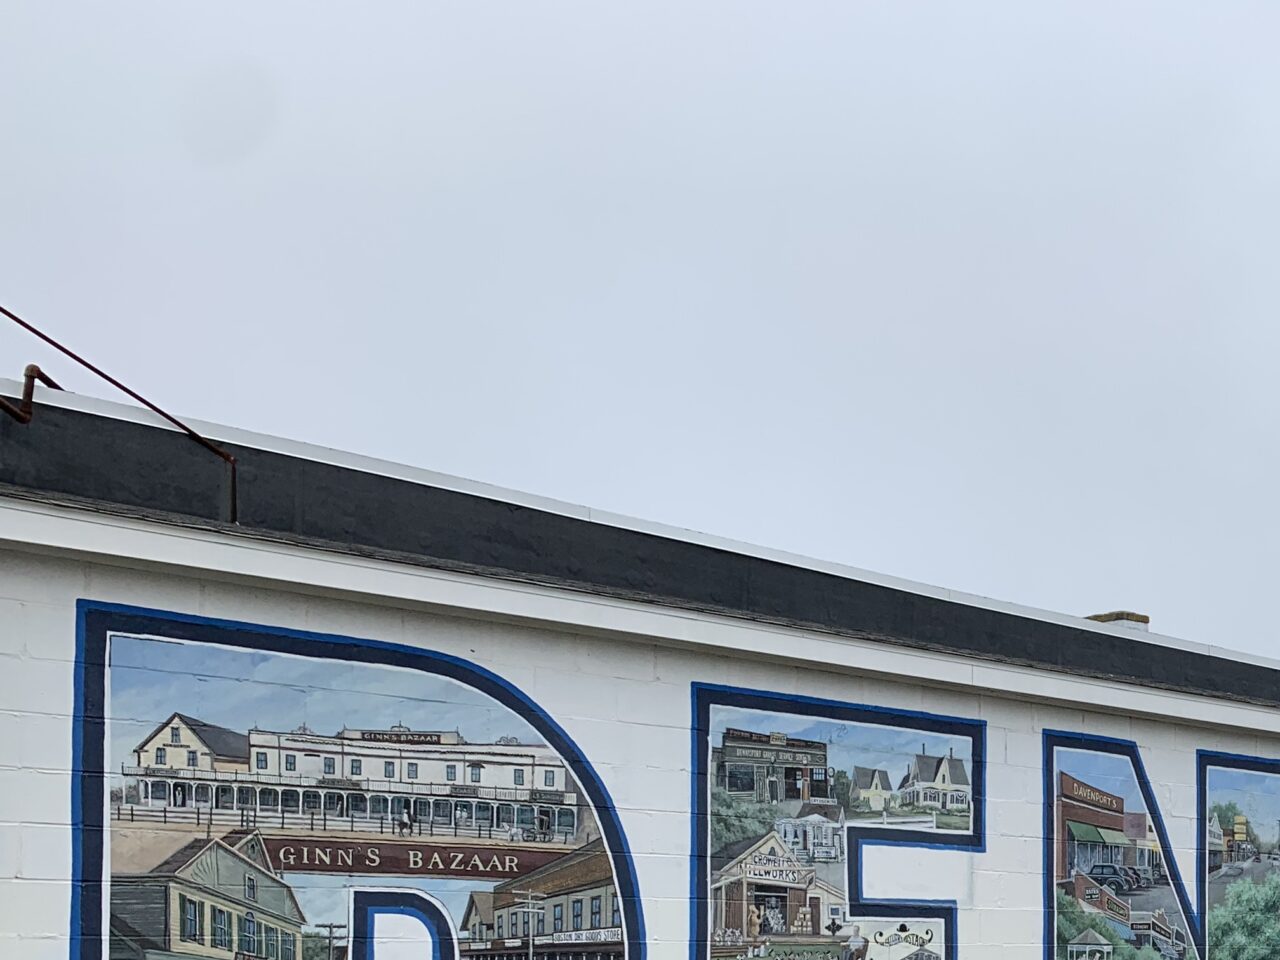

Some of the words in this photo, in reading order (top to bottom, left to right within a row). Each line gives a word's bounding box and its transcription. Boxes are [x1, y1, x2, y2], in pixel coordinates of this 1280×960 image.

[401, 734, 438, 742] BAZAAR
[279, 845, 381, 866] GINN'S
[408, 850, 520, 872] BAZAAR
[603, 929, 620, 941] STORE
